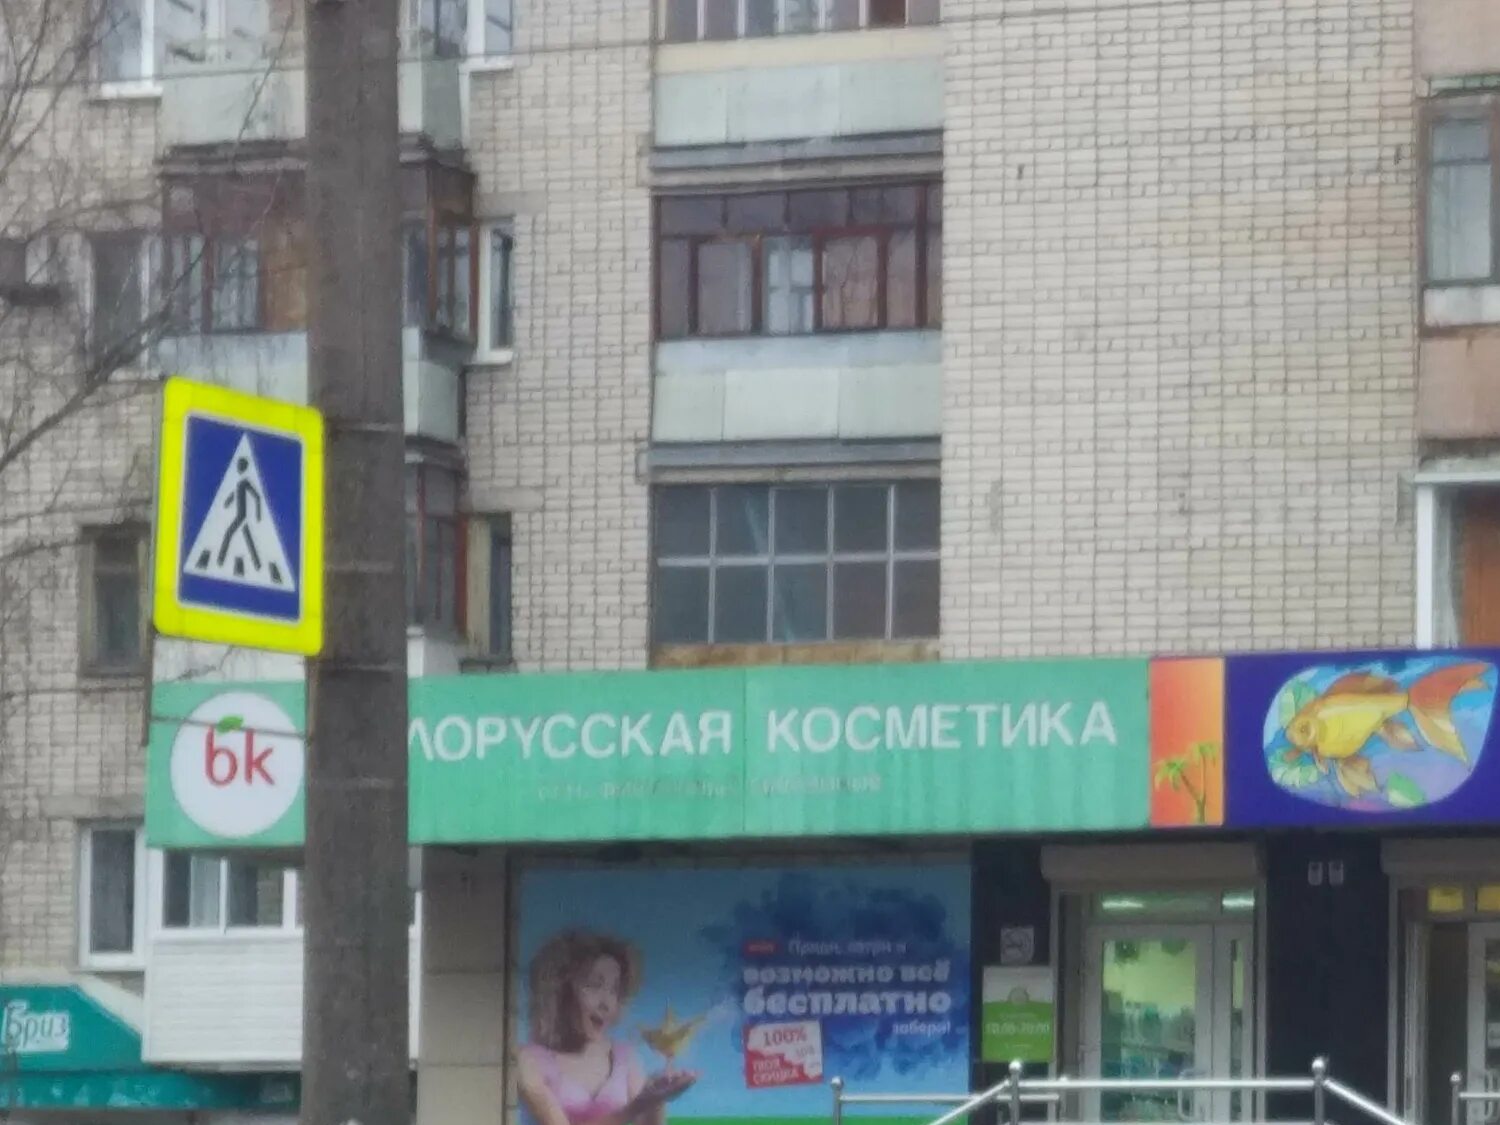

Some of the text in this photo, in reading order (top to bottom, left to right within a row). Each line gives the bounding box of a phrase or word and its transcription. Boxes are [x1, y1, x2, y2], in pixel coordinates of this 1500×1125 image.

[408, 701, 1119, 762] ЛОРУССКАЯ КОСМЕТИКА
[743, 965, 894, 984] возможно
[743, 985, 952, 1015] бесплатно
